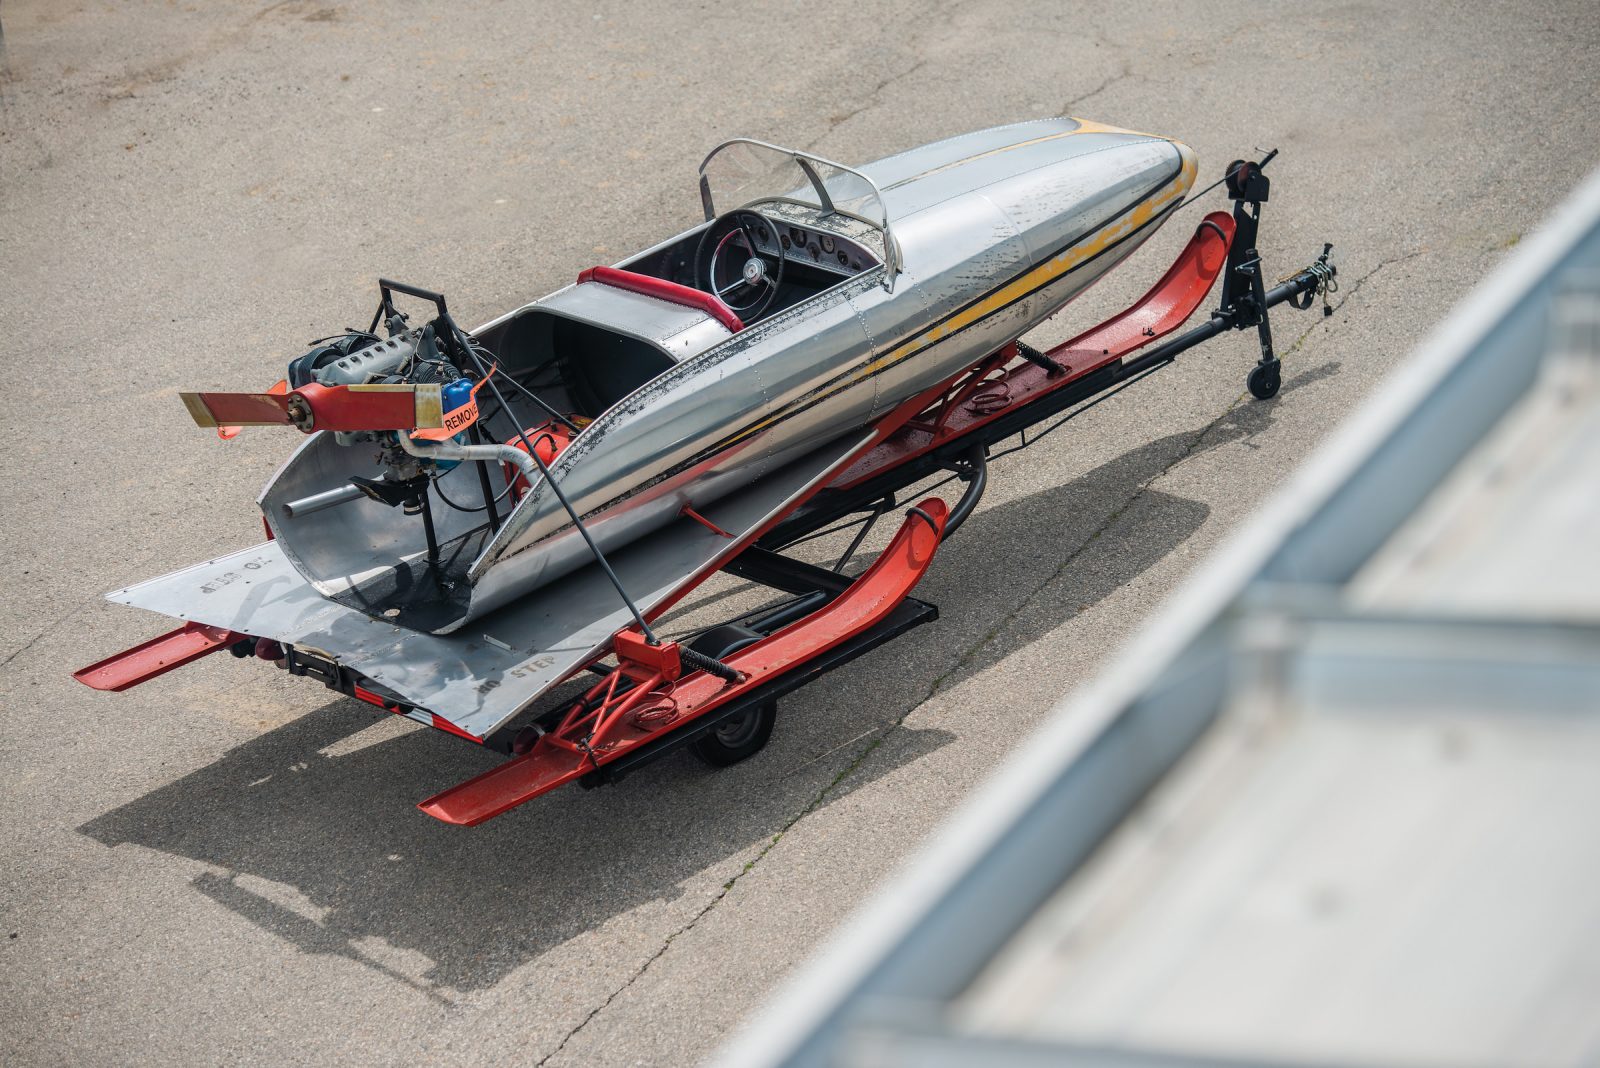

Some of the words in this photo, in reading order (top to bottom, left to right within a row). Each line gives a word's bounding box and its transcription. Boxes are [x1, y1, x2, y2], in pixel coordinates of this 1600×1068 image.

[445, 403, 478, 431] REMOVE
[244, 556, 273, 570] O
[510, 656, 555, 679] STEP
